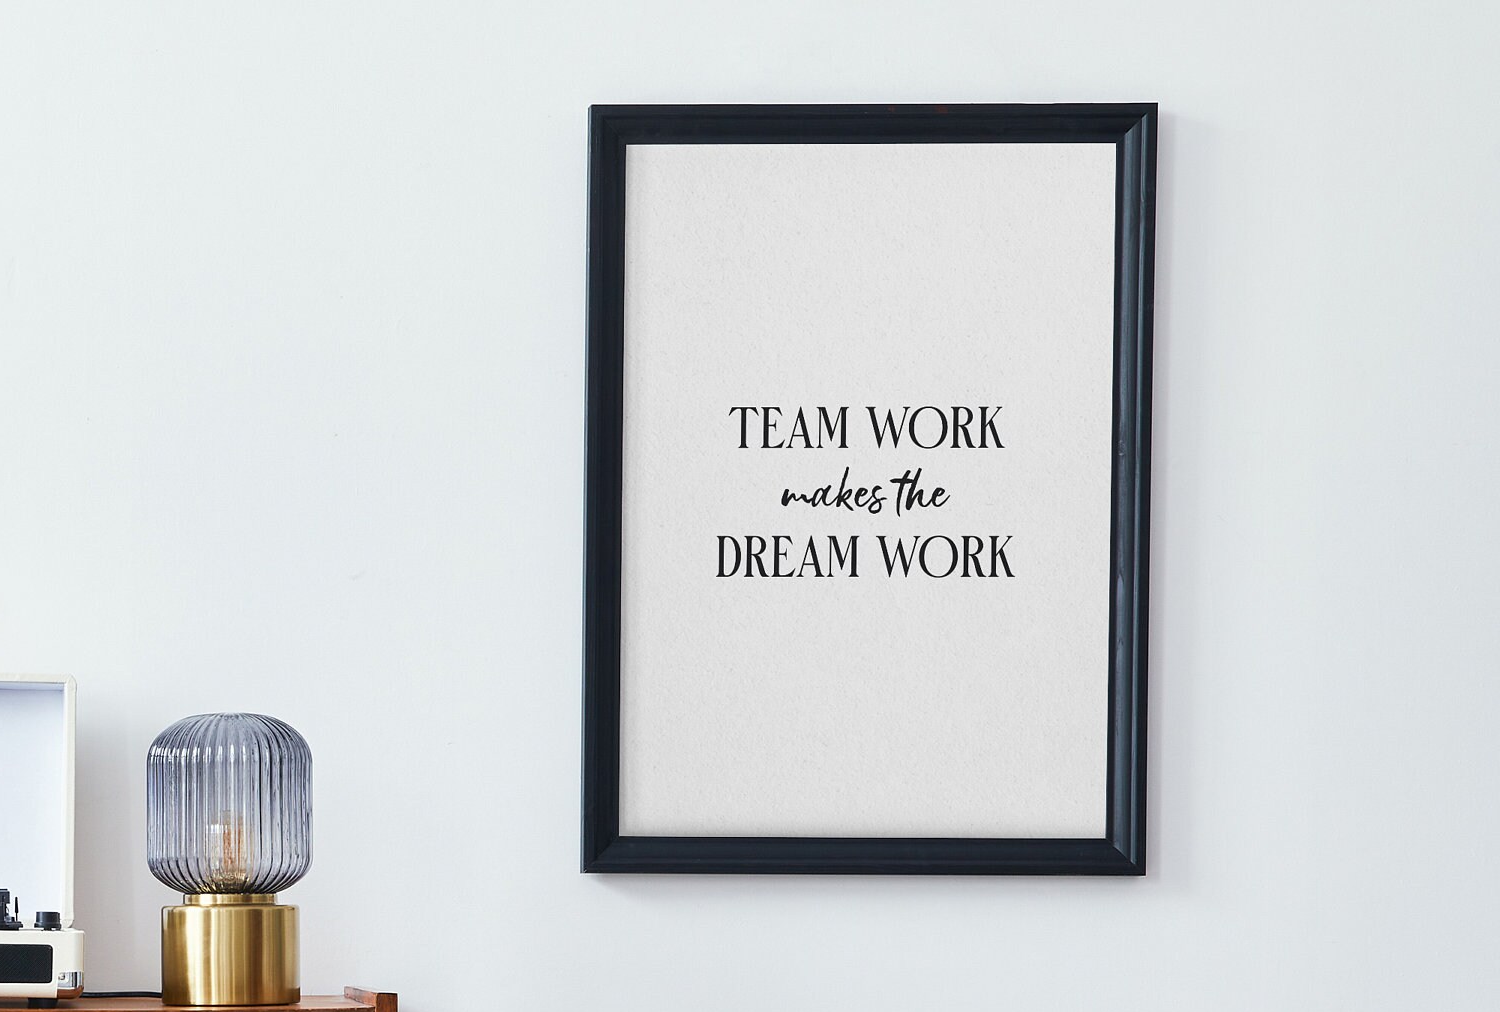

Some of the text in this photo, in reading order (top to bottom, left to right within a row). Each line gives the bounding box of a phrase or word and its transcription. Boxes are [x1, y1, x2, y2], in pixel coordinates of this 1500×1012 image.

[728, 406, 1006, 449] TEAM WORK
[781, 466, 951, 517] makes the
[715, 535, 1016, 578] DREAM WORK
